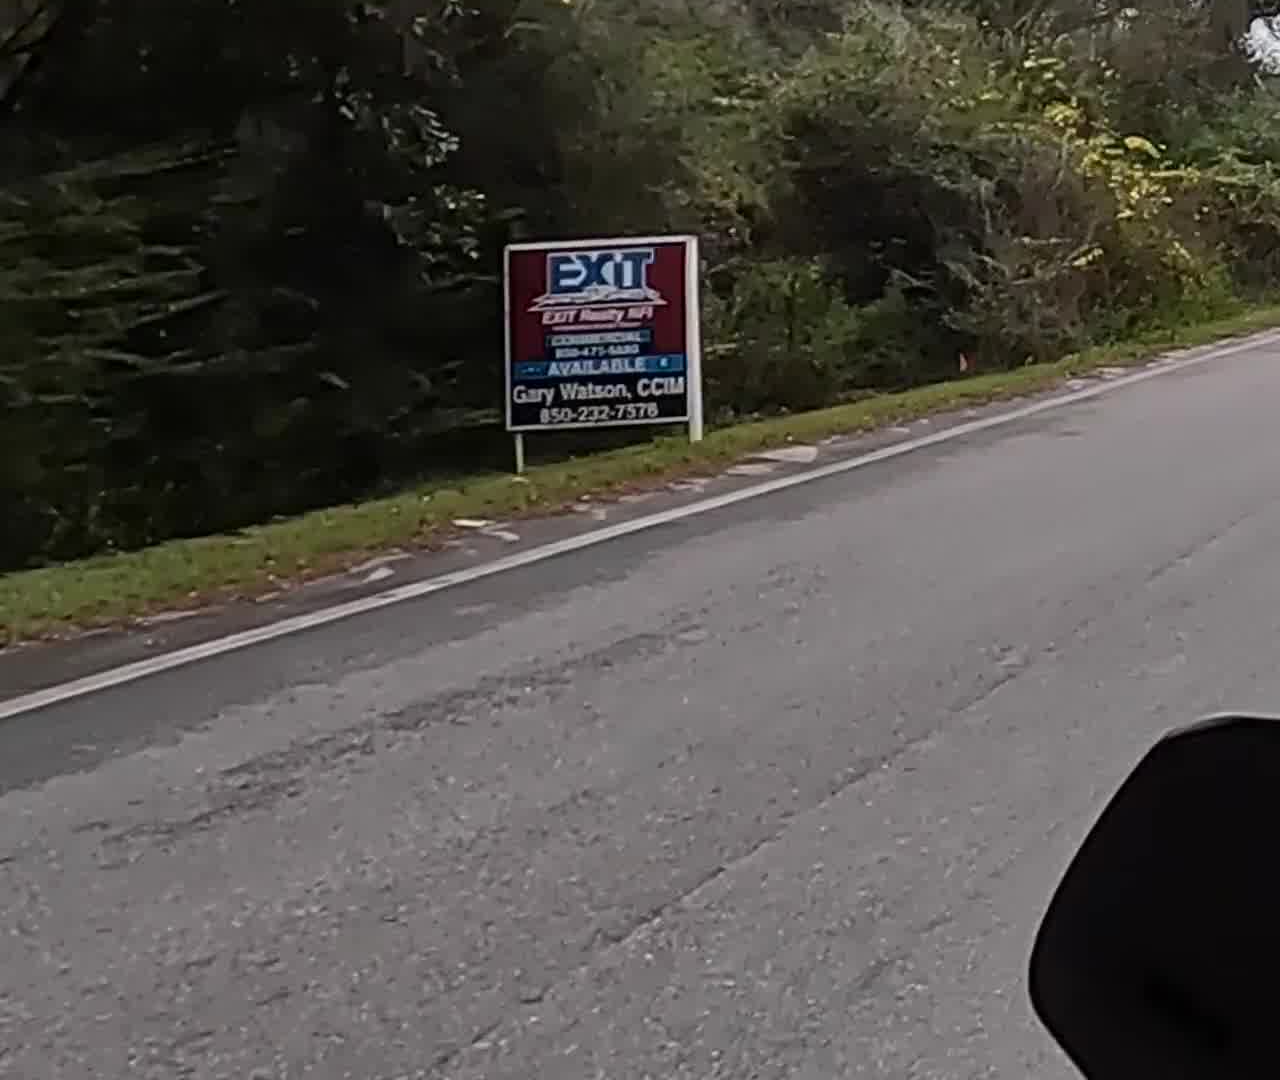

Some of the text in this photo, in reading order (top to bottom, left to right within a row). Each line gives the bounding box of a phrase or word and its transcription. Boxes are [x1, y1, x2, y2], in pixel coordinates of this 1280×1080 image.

[548, 249, 654, 295] EXIT
[541, 310, 577, 325] EXIT
[547, 357, 647, 377] AVAILABLE
[512, 385, 555, 406] Gary
[560, 382, 632, 400] Watson,
